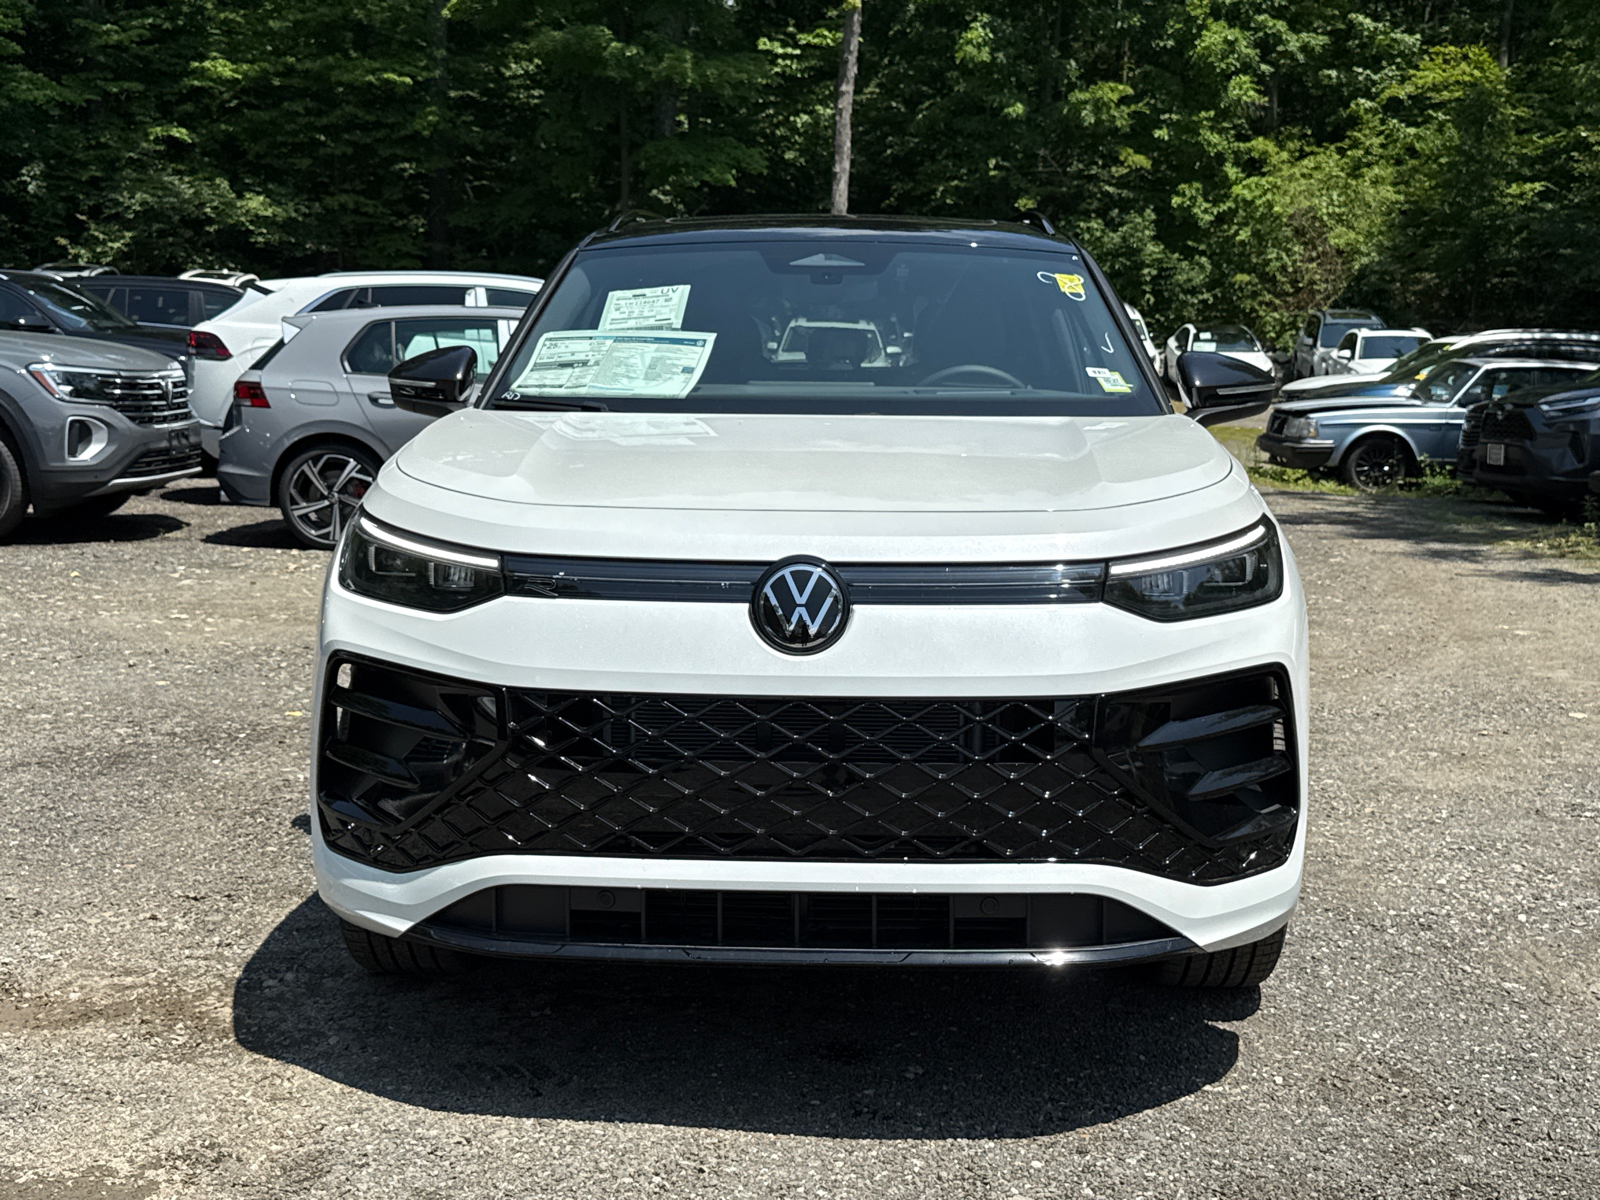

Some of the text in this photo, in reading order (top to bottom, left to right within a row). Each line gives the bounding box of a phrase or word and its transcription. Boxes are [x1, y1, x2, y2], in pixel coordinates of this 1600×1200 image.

[661, 287, 679, 295] UV
[524, 577, 559, 597] R
[759, 562, 844, 648] VW
